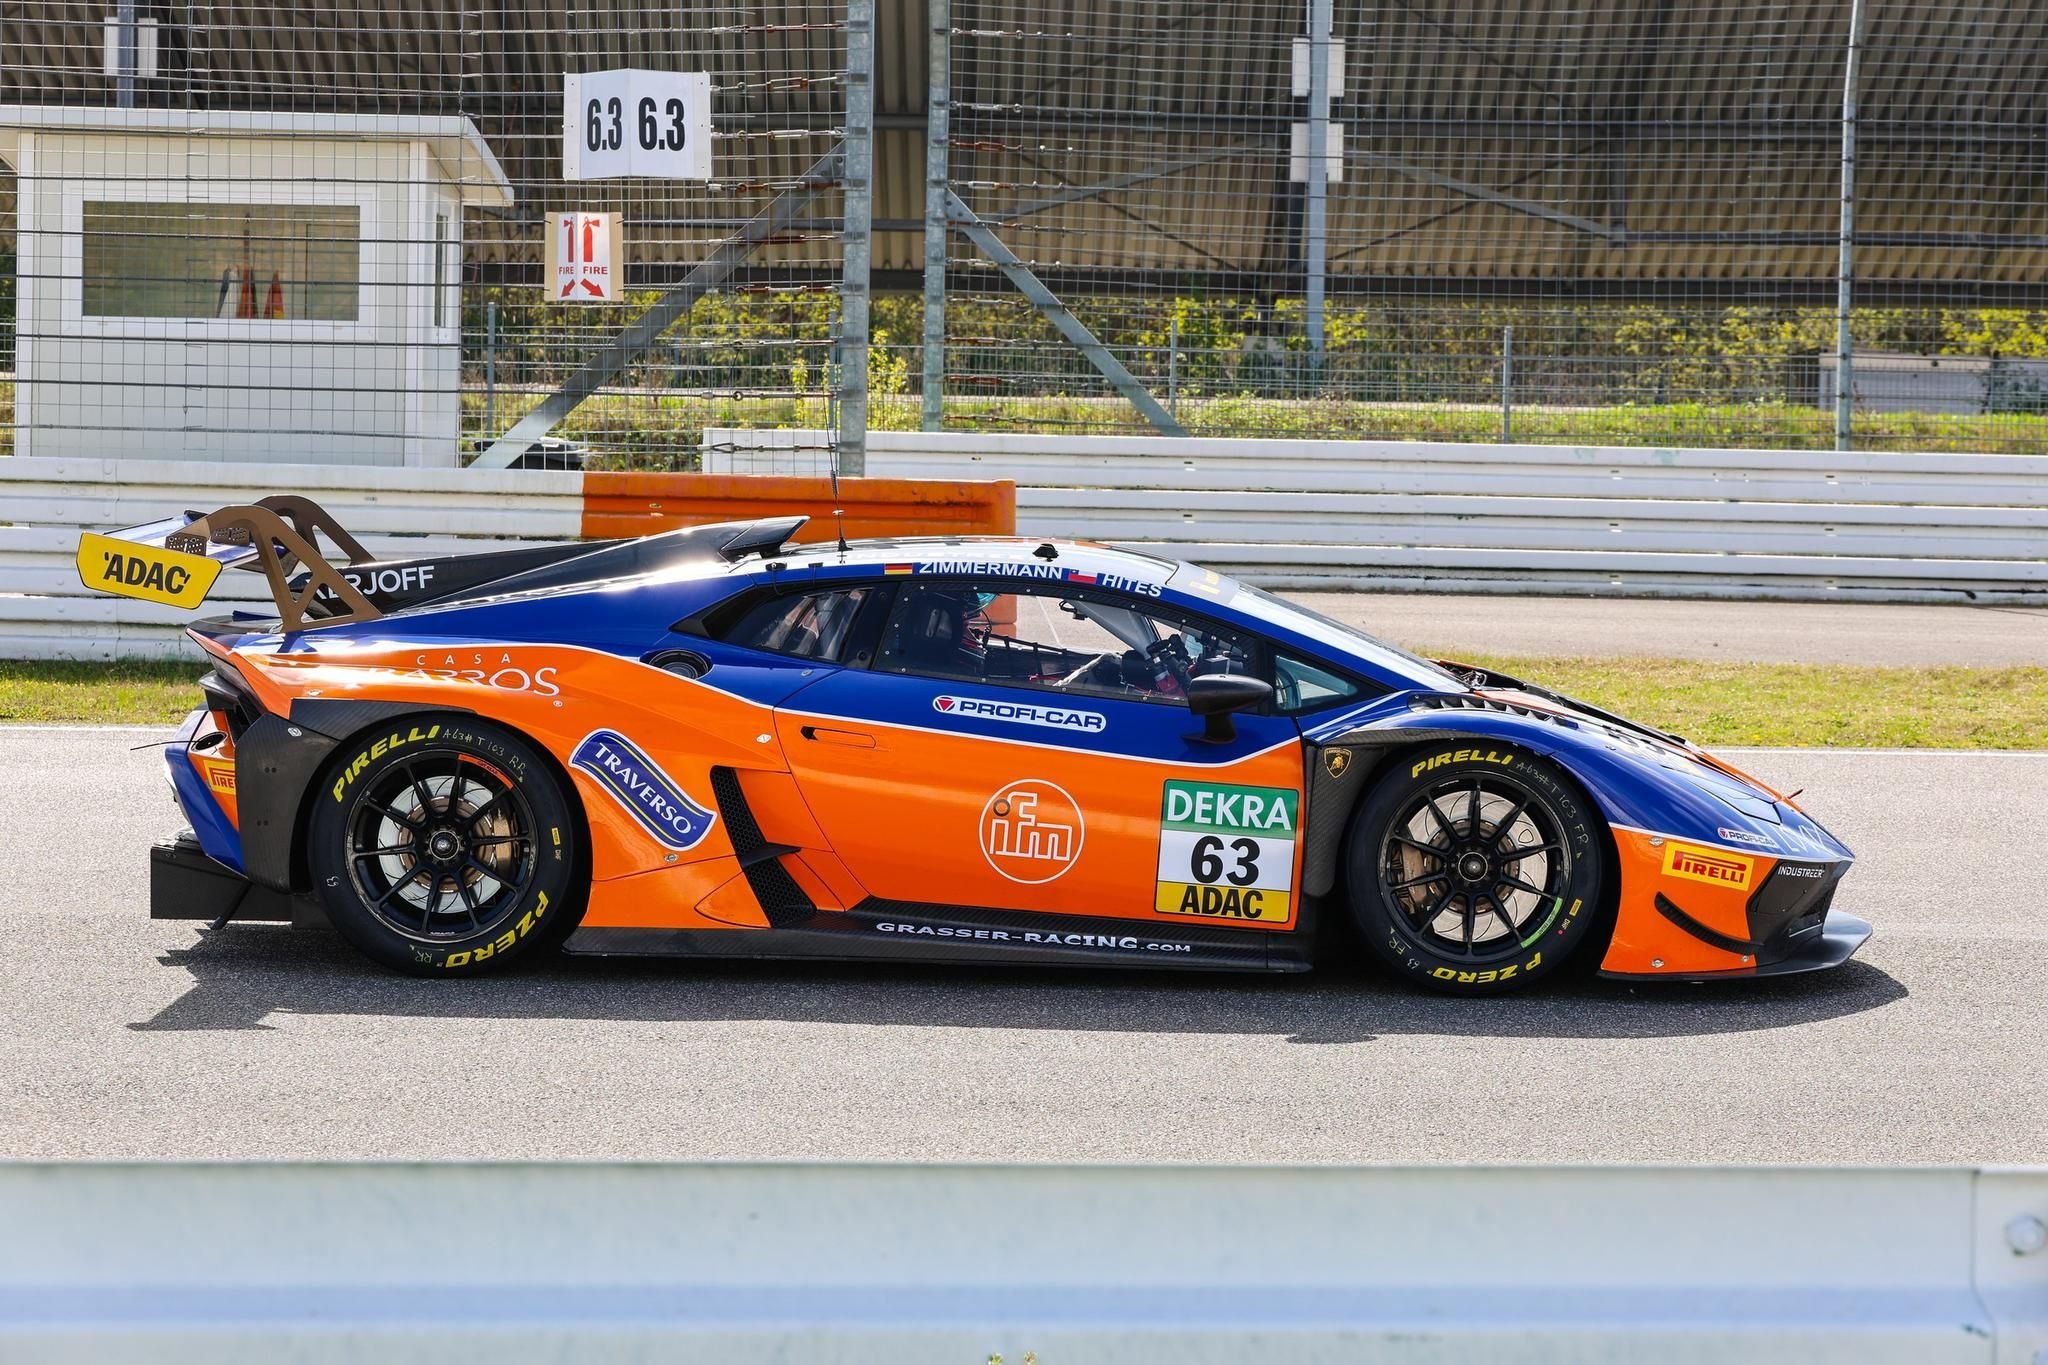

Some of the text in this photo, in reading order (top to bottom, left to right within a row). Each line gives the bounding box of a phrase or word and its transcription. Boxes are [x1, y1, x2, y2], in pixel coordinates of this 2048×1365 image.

[587, 97, 622, 151] 6.3
[638, 97, 685, 151] 6.3
[559, 266, 574, 275] FIRE
[583, 266, 608, 275] FIRE
[919, 562, 1063, 580] ZIMMERMANN
[1102, 574, 1162, 598] HITES
[416, 653, 511, 666] CASA
[959, 701, 1102, 729] PROFI-CAR
[333, 725, 440, 802] PIRELLI
[1412, 750, 1514, 778] PIRELLI
[594, 743, 691, 833] TRAVERSO
[990, 792, 1072, 861] ifm
[1167, 789, 1292, 831] DEKRA
[1190, 835, 1261, 887] 63
[1671, 850, 1747, 883] PIRELLI
[1778, 866, 1823, 878] INDUSTREER
[1179, 885, 1263, 918] ADAC
[445, 890, 549, 968] P ZERO
[1432, 951, 1542, 984] P ZERO
